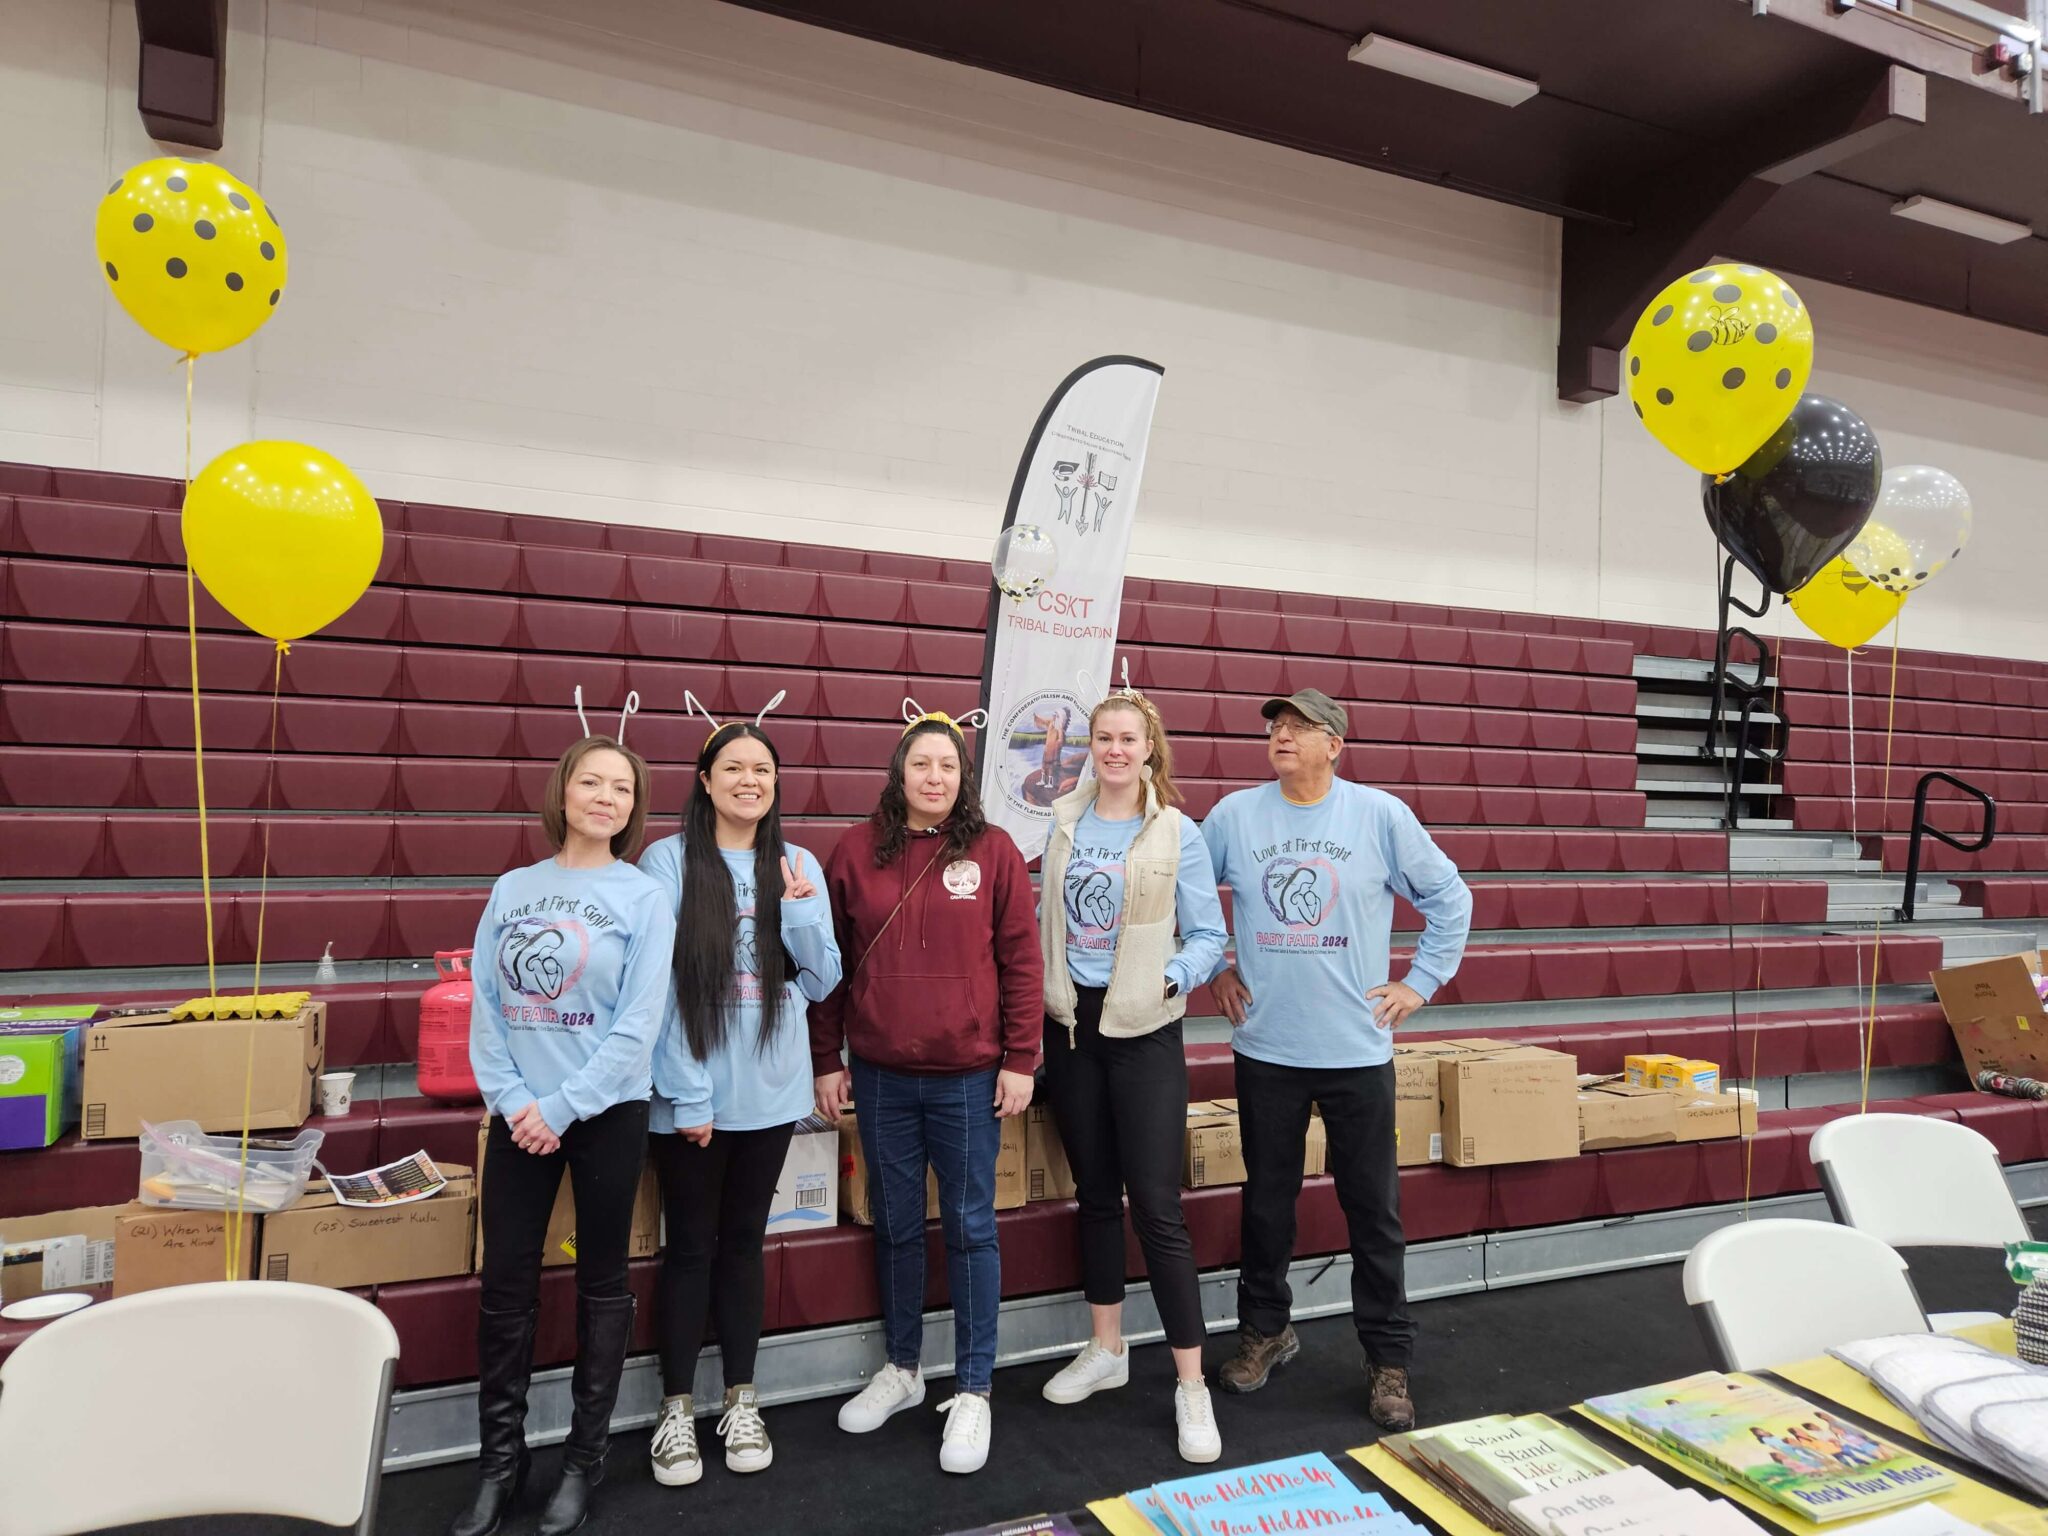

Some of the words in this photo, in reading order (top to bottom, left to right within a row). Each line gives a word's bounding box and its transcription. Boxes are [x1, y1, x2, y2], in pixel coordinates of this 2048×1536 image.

[1038, 590, 1094, 619] CSKT
[1007, 614, 1049, 634] TRIBAL
[1061, 693, 1074, 702] AND
[1023, 804, 1052, 818] FLATHEAD
[1083, 846, 1097, 859] at
[1252, 844, 1279, 864] Love
[1282, 839, 1292, 854] at
[1295, 837, 1321, 853] First
[1323, 840, 1353, 863] Sight
[502, 903, 531, 924] Love
[534, 896, 547, 913] at
[548, 894, 581, 915] First
[580, 903, 615, 930] Sight
[1079, 934, 1111, 951] FAIR
[1256, 931, 1285, 947] BABY
[1286, 933, 1319, 948] FAIR
[1321, 935, 1349, 948] 2024
[521, 1005, 559, 1024] FAIR
[561, 1011, 596, 1028] 2024
[131, 1222, 158, 1240] (21)
[163, 1223, 200, 1237] When
[205, 1223, 225, 1233] We
[313, 1218, 345, 1236] (25)
[348, 1215, 404, 1229] Sweetest
[409, 1210, 440, 1224] Kulu
[162, 1238, 185, 1249] Are
[190, 1236, 217, 1247] Kind
[1464, 1427, 1522, 1449] Stand
[1494, 1439, 1556, 1464] Stand
[1512, 1461, 1562, 1481] Like
[1173, 1490, 1218, 1512] You
[1215, 1474, 1266, 1502] Hold
[1258, 1472, 1304, 1494] Me
[1301, 1466, 1336, 1489] Up
[1535, 1481, 1550, 1494] A
[1792, 1480, 1850, 1507] Rock
[1847, 1476, 1894, 1496] Your
[1887, 1464, 1943, 1488] Mocs
[1541, 1504, 1579, 1521] On
[1575, 1493, 1616, 1512] the
[1210, 1519, 1257, 1536] You
[1257, 1509, 1309, 1535] Hold
